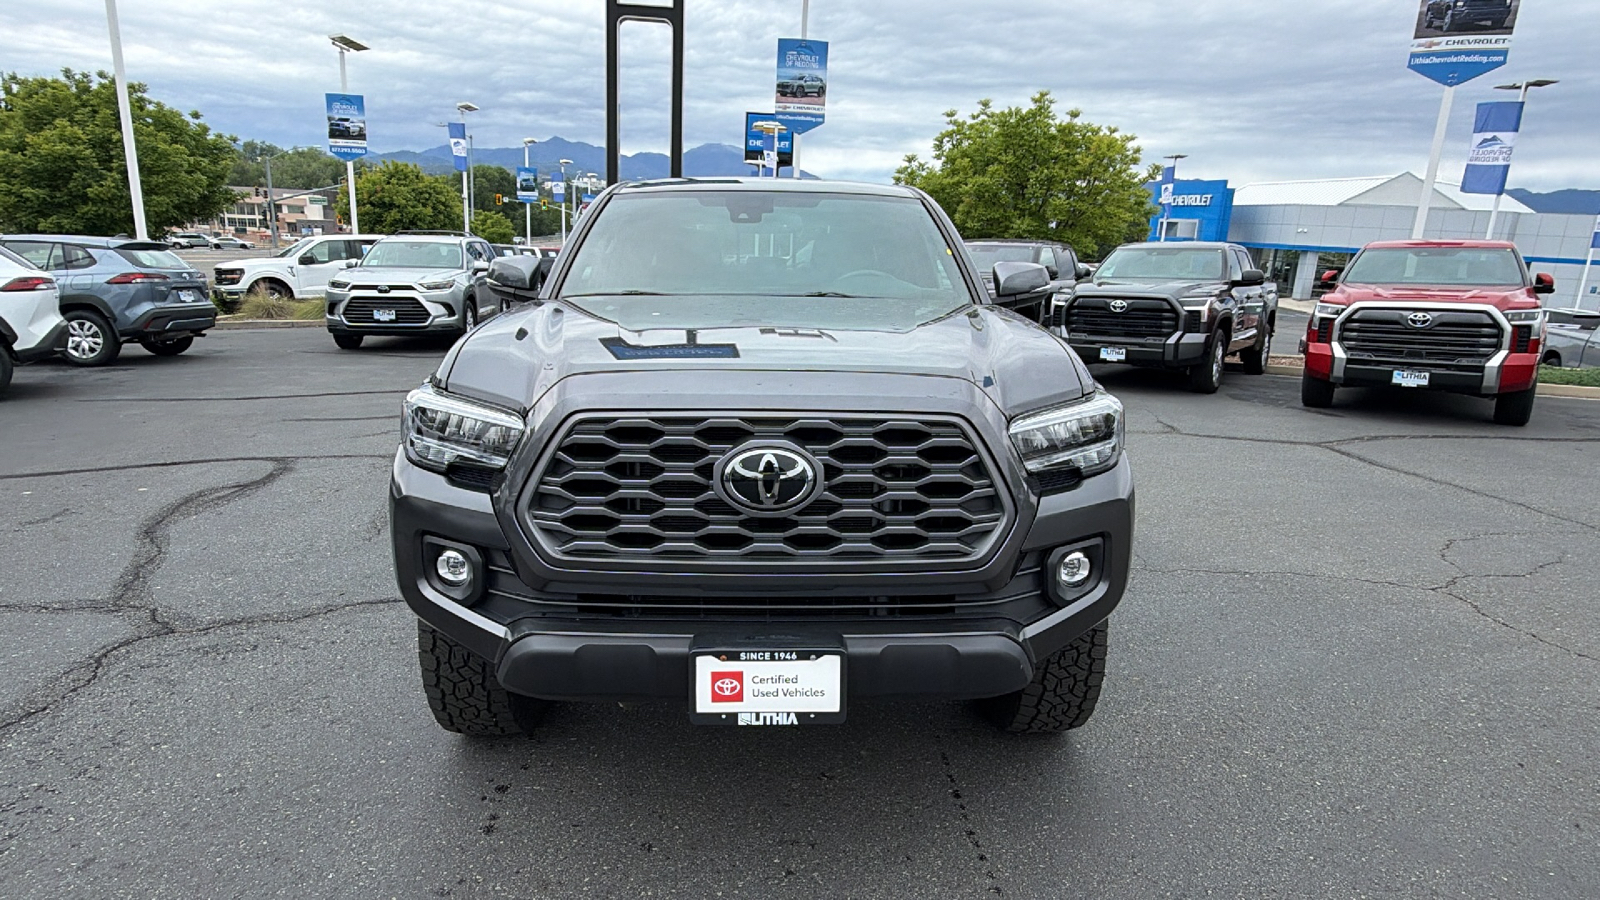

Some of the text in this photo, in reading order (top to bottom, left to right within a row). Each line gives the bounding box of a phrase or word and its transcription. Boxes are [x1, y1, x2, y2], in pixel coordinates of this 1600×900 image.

[1445, 38, 1507, 46] CHEVROLET
[786, 55, 819, 63] CHEVROLET
[1410, 54, 1504, 65] LithiaChevroletRedding.com
[795, 61, 819, 69] REDDING
[749, 139, 790, 148] CHELET
[1171, 195, 1213, 206] CHEVROLET
[1401, 372, 1428, 380] LITHIA
[740, 652, 797, 660] SINCE 1946
[751, 674, 798, 684] Certified
[752, 688, 825, 698] Used Vehicles
[751, 712, 799, 725] LITHIA
